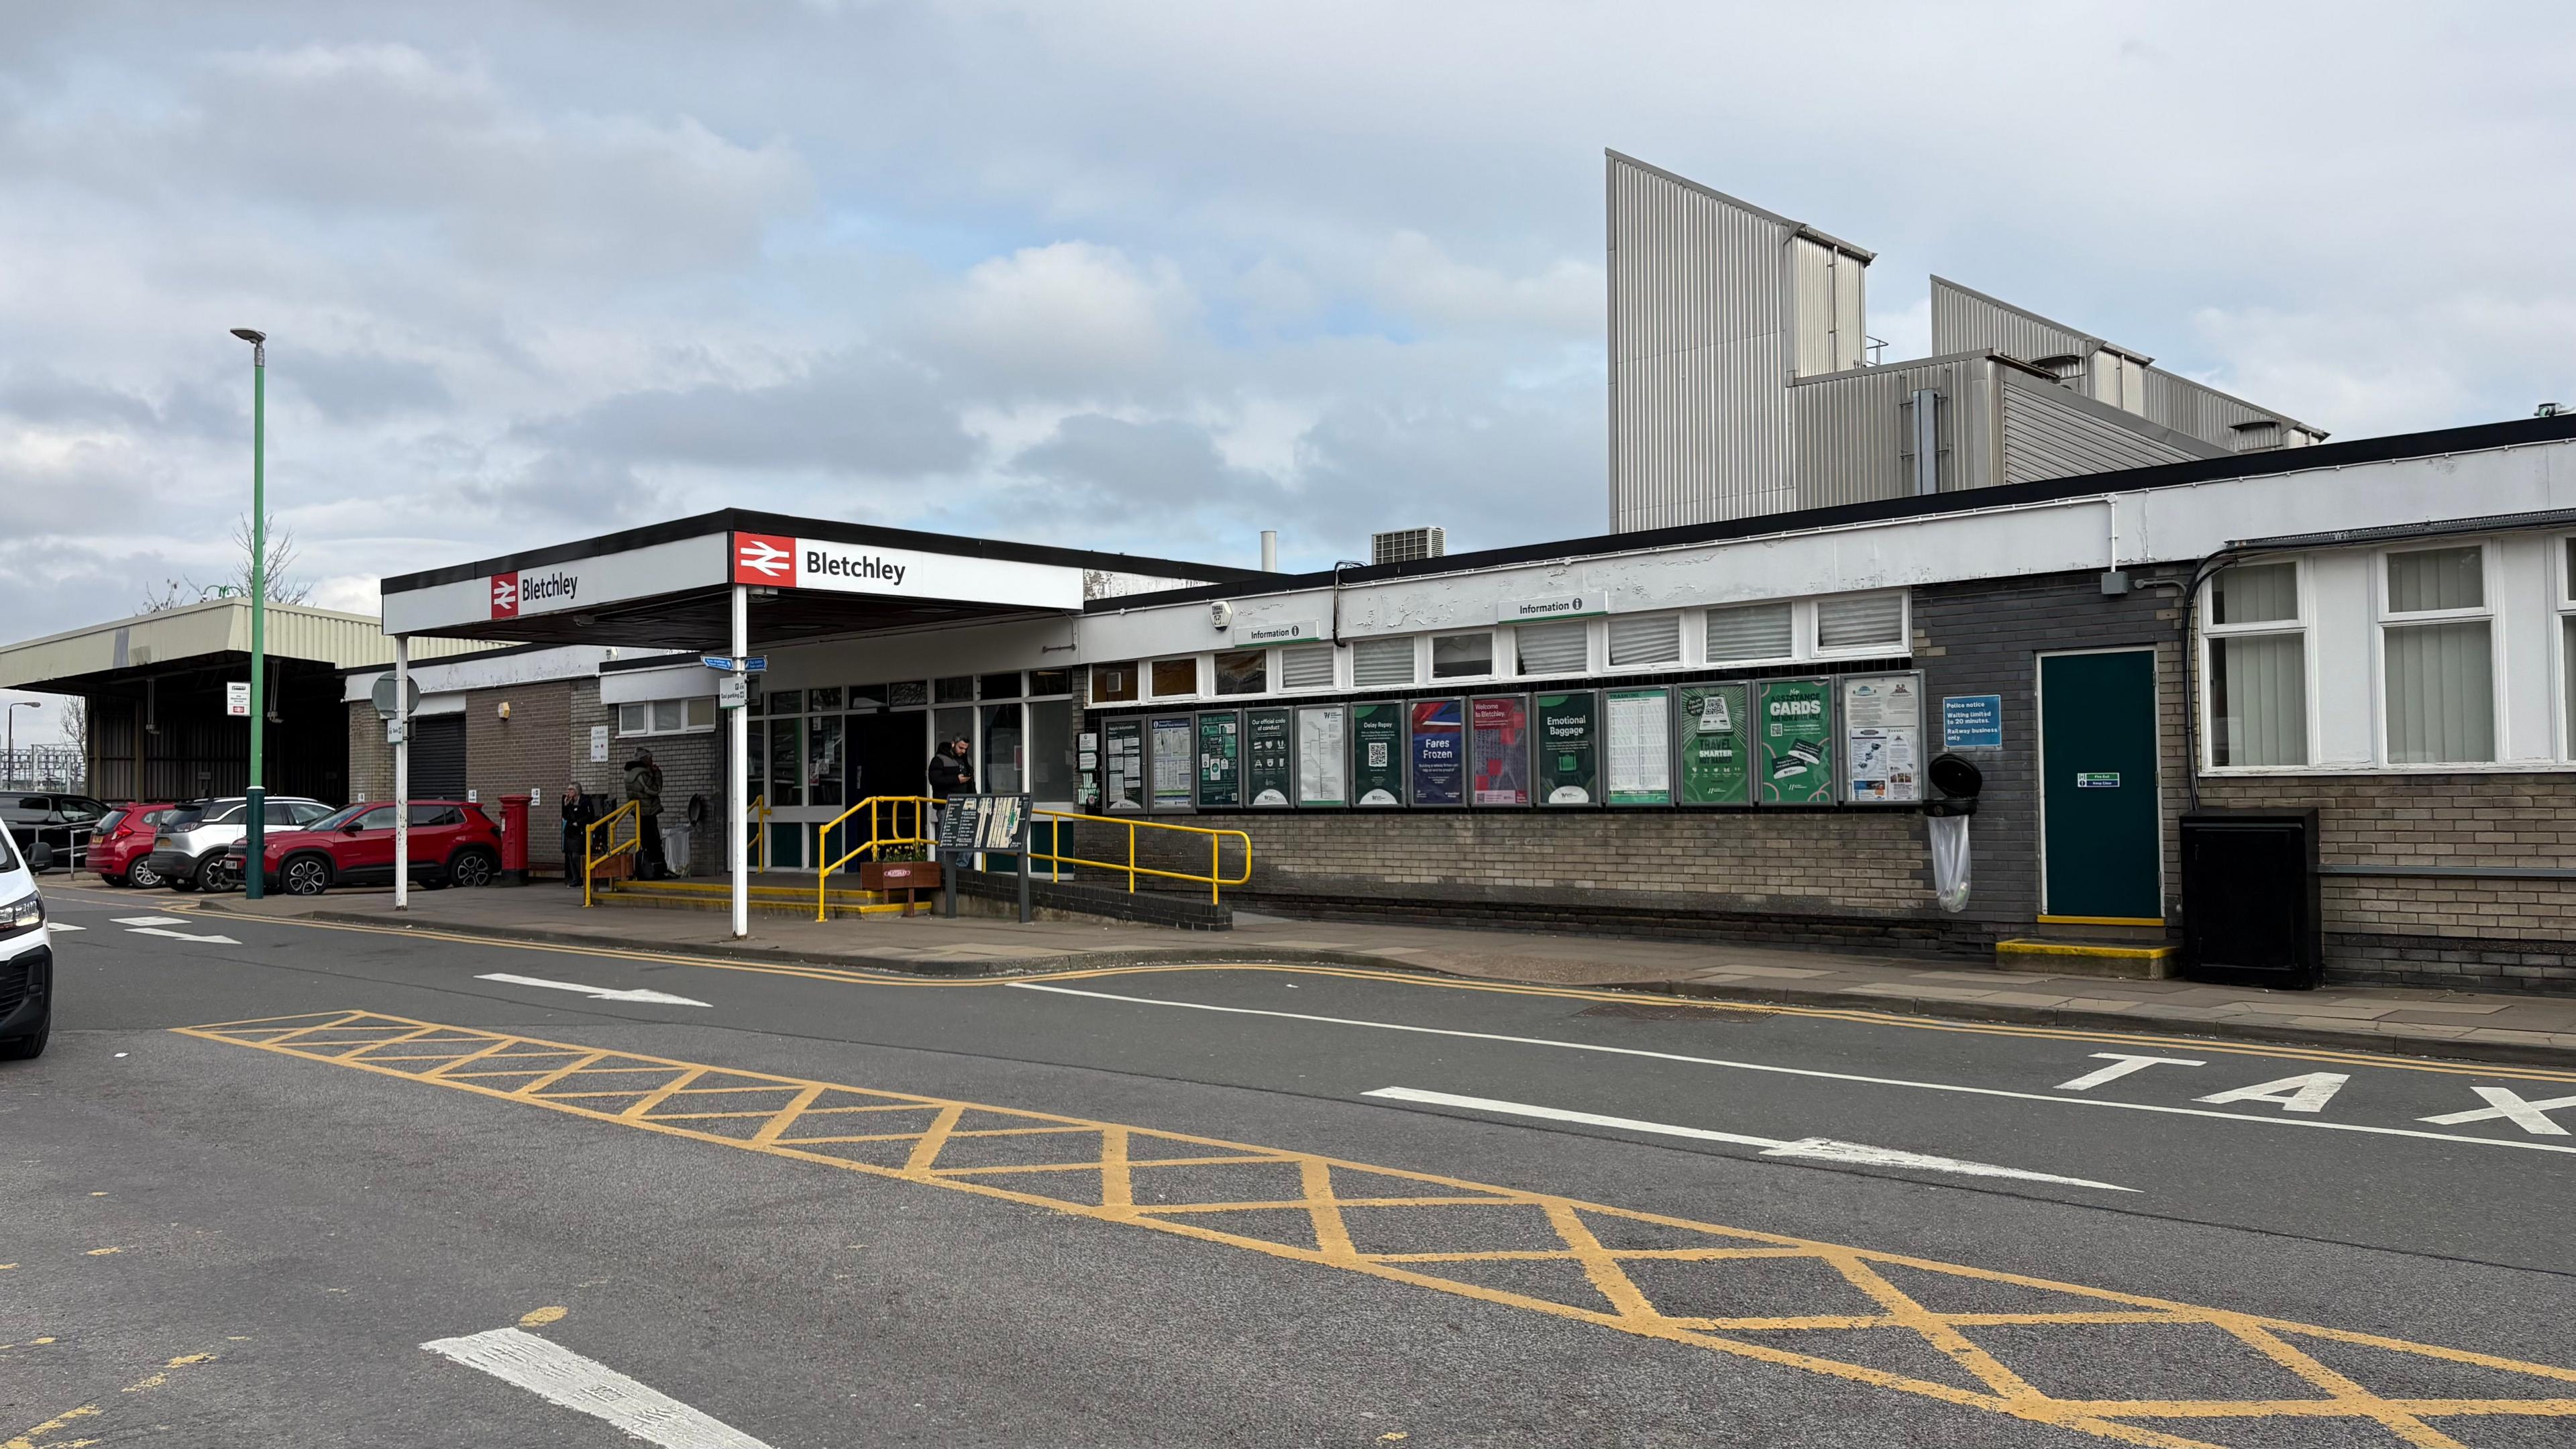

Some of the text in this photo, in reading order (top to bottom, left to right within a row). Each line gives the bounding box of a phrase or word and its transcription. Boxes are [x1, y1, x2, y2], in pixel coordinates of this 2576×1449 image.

[806, 551, 906, 586] Bletchley
[521, 572, 578, 602] Bletchley
[1519, 602, 1570, 614] Information
[1251, 629, 1289, 639] Information
[1771, 694, 1821, 702] ASSISTANCE
[1770, 700, 1821, 716] CARDS
[1547, 714, 1586, 725] Emotional
[1550, 727, 1584, 737] Baggage
[1426, 739, 1450, 749] Fares
[1699, 739, 1731, 750] TRAVEL
[1423, 750, 1452, 759] Frozen
[1082, 773, 1093, 788] TAP
[1078, 789, 1088, 804] TAP
